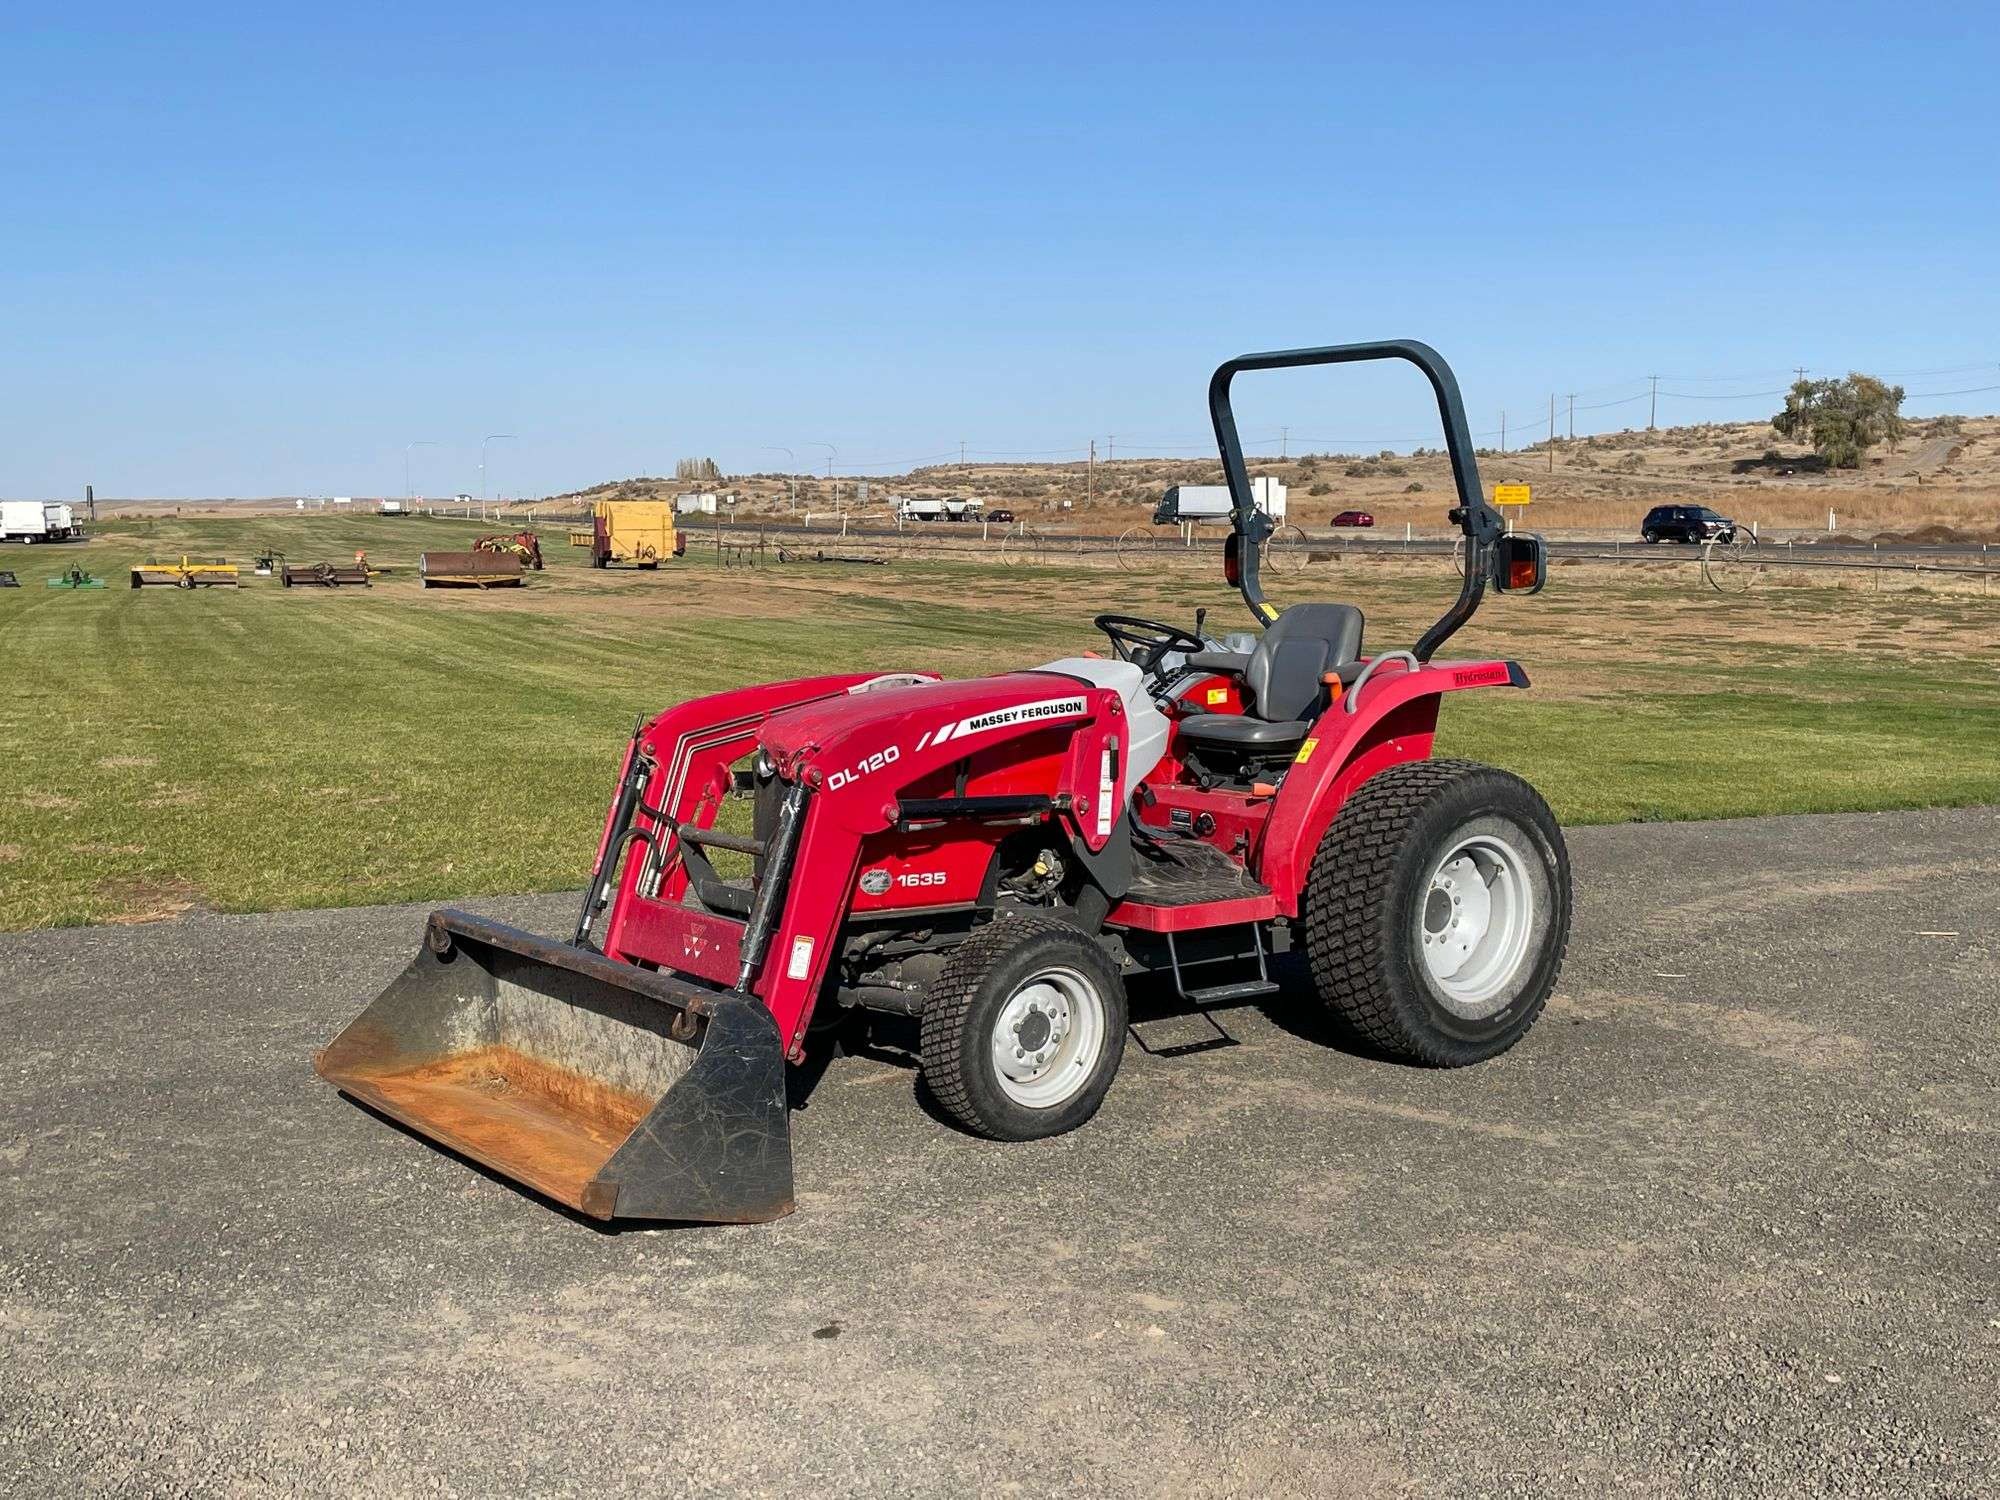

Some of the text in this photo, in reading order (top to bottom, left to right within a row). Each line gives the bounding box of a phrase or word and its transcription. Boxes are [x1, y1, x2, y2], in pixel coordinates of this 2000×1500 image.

[969, 701, 1082, 730] MASSEY FERGUSON
[897, 872, 946, 888] 1635
